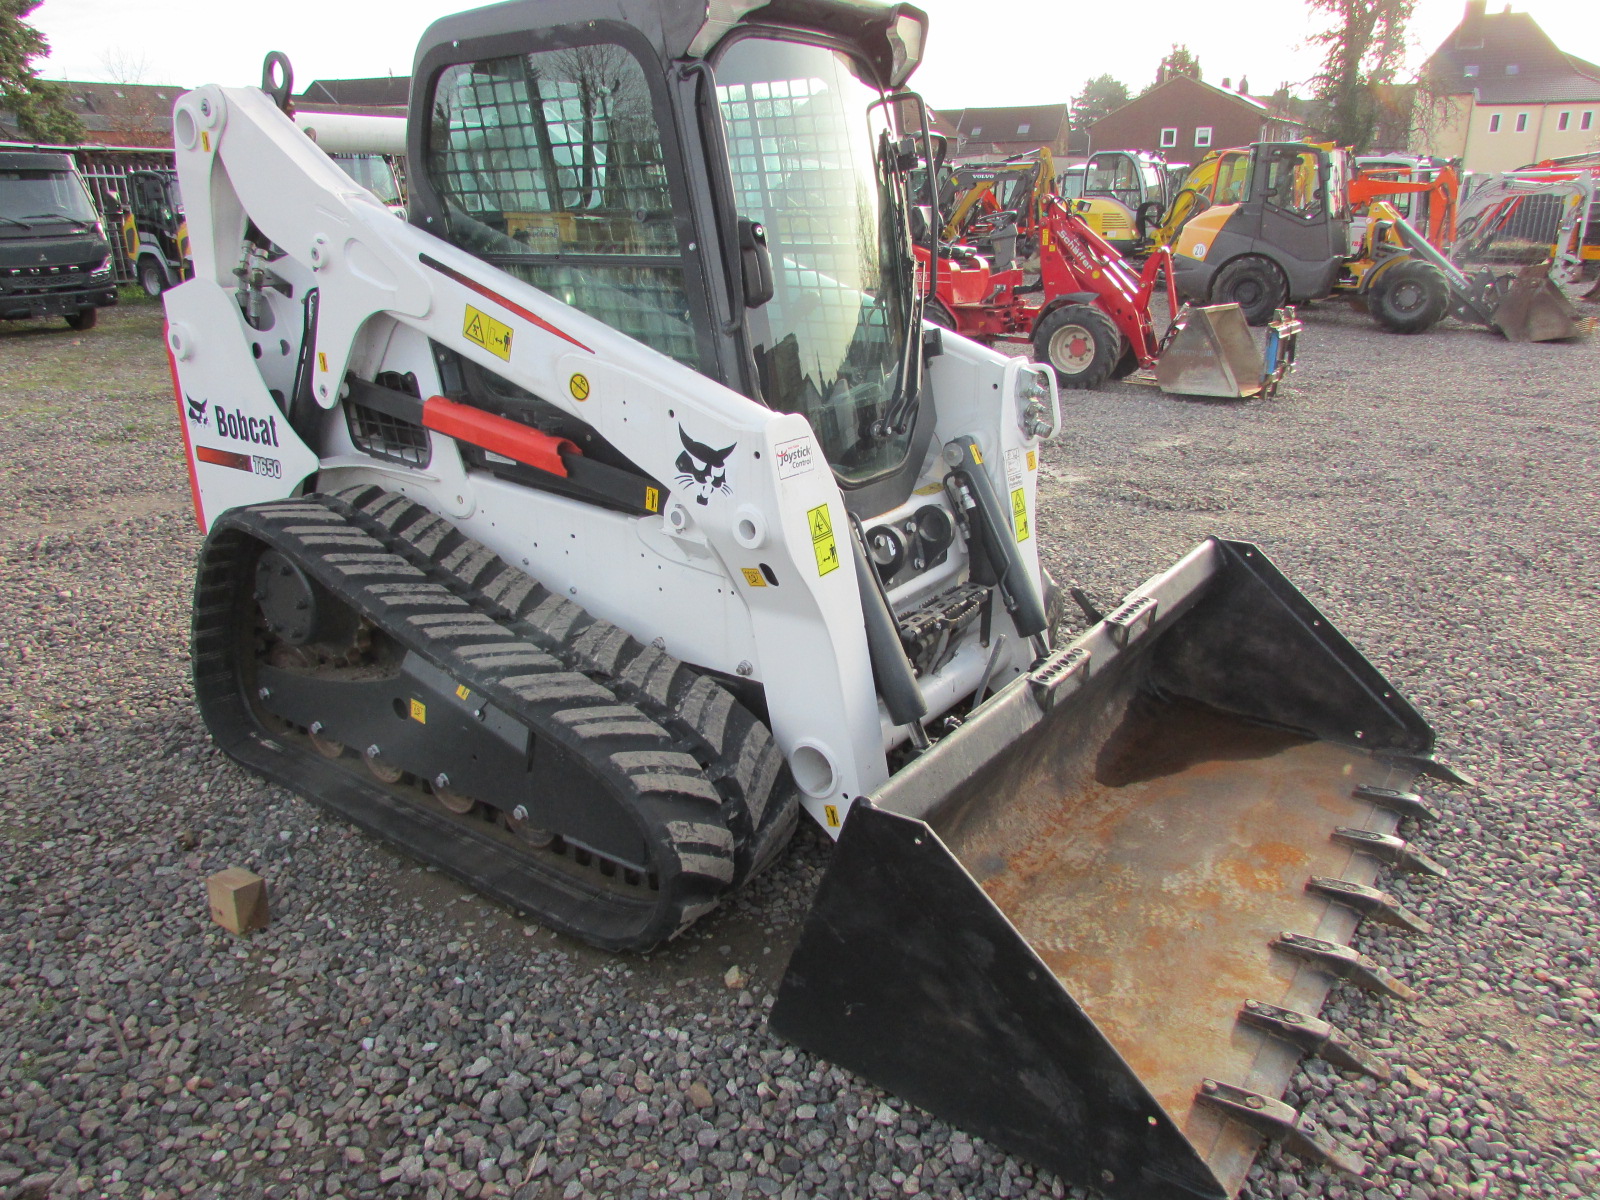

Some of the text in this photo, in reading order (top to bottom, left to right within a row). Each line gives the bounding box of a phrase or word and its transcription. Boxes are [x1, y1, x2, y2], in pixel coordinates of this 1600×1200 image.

[1194, 245, 1204, 256] 20
[215, 405, 279, 447] Bobcat
[252, 455, 282, 479] T650
[792, 458, 811, 469] Control
